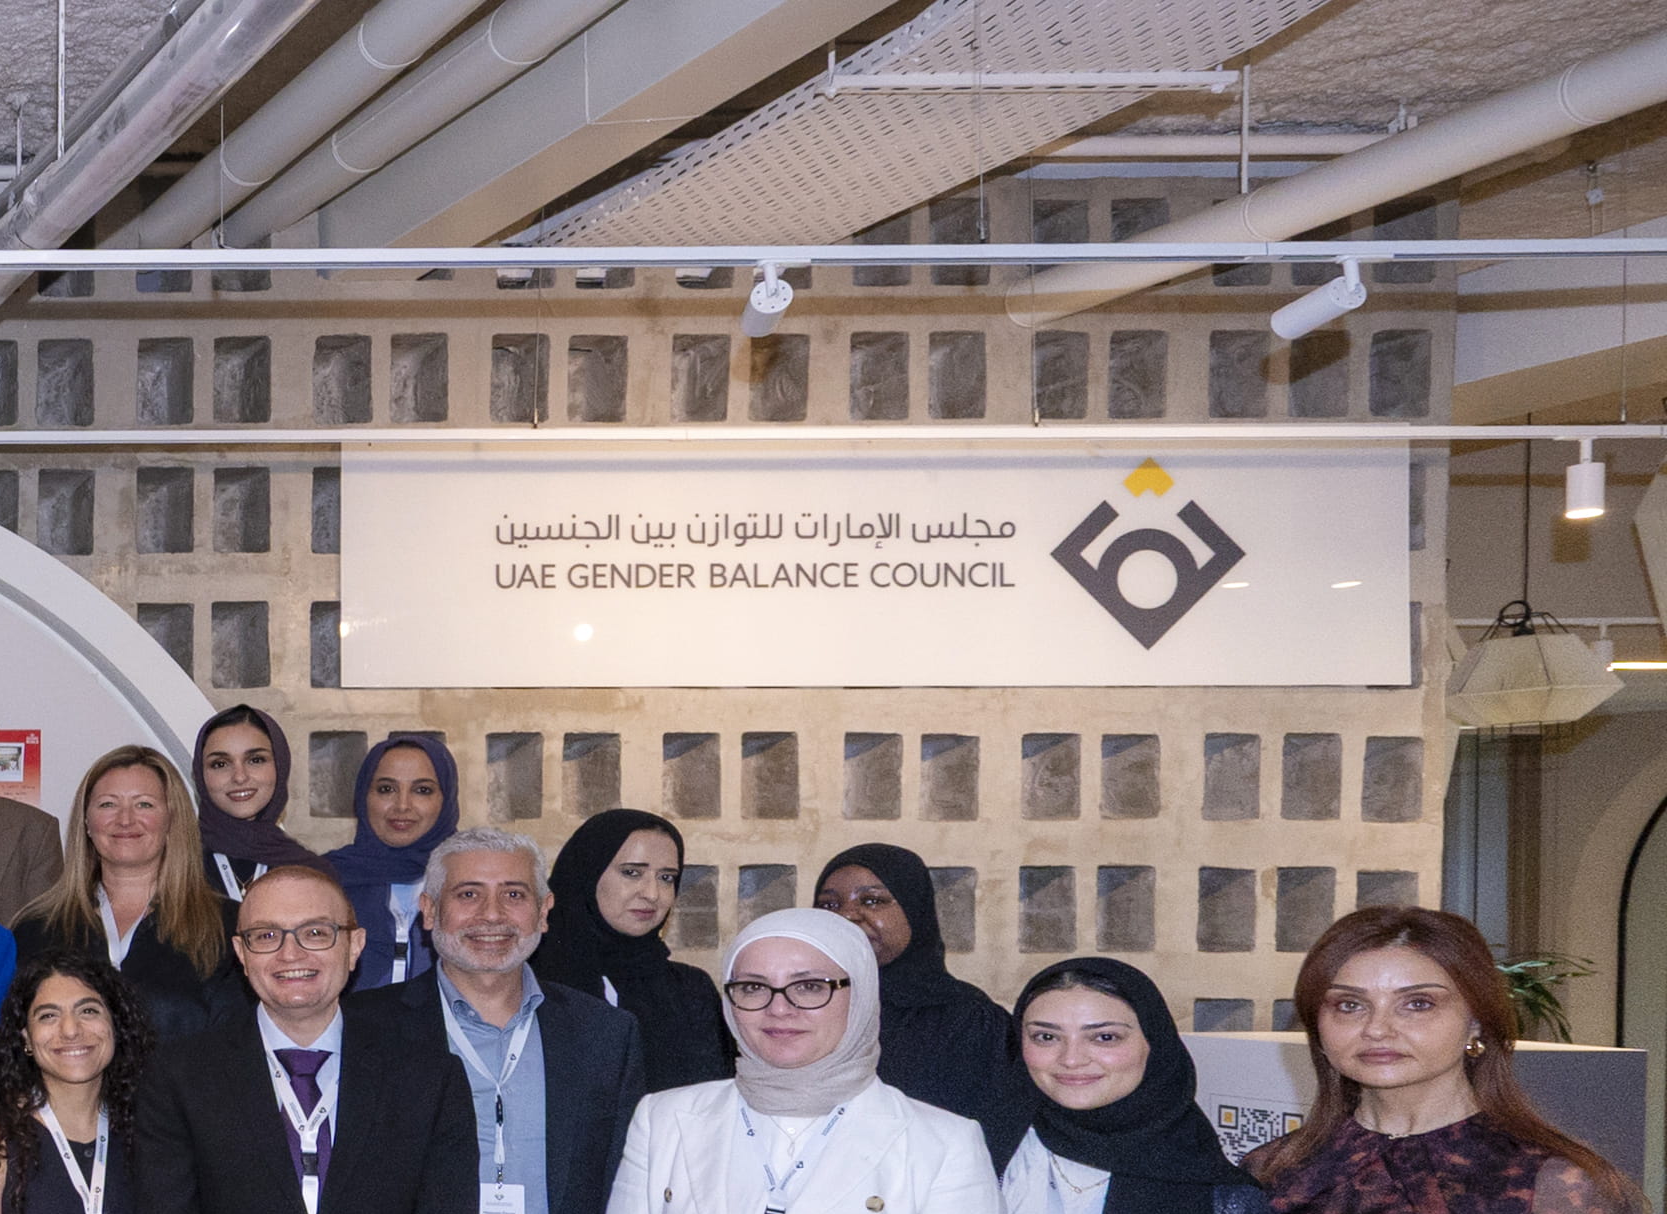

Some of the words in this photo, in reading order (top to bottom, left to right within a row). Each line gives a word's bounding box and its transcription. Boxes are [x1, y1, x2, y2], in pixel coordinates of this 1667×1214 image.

[495, 513, 620, 549] الجنسين
[631, 513, 676, 549] بين
[687, 512, 783, 547] للتوازن
[794, 512, 900, 550] الإمارات
[912, 512, 1016, 546] مجلس
[495, 563, 556, 589] UAE
[567, 562, 696, 589] GENDER
[709, 561, 858, 588] BALANCE
[869, 561, 1015, 588] COUNCIL
